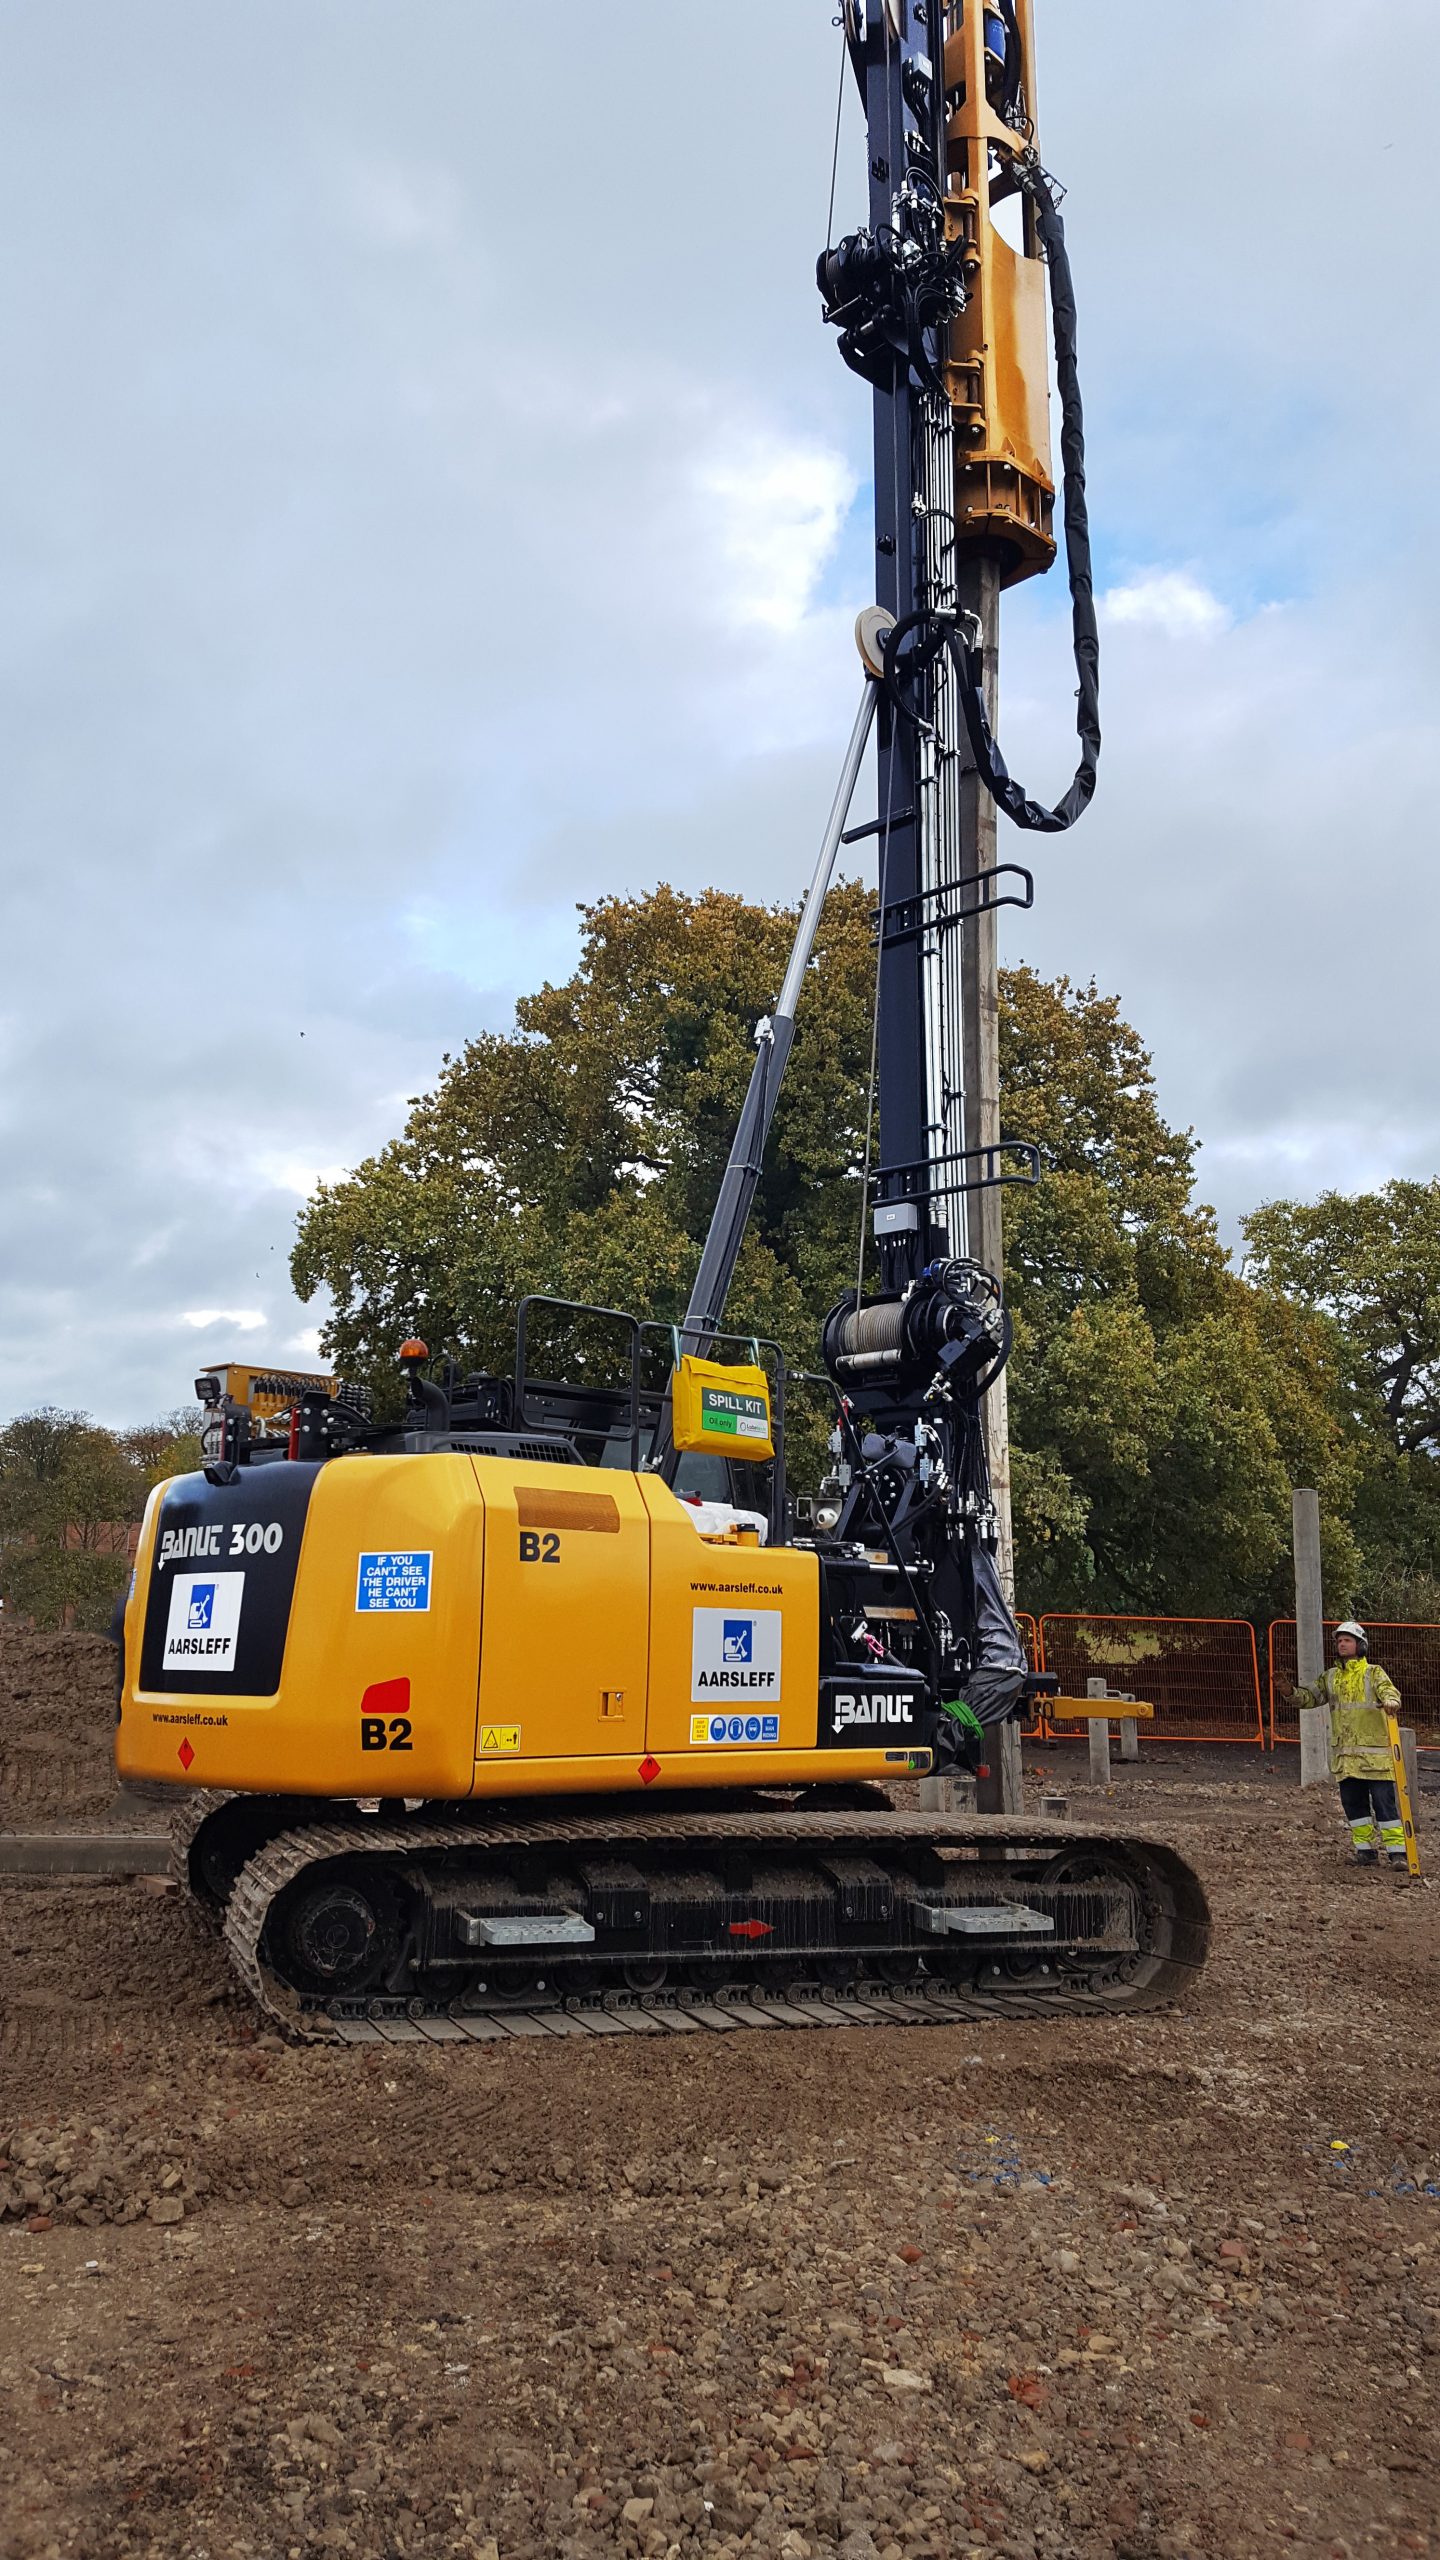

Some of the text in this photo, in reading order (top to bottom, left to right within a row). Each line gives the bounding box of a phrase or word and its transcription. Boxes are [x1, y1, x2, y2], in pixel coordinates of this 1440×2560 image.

[709, 1394, 762, 1414] SPILL KIT
[719, 1419, 732, 1428] only
[160, 1523, 283, 1561] BANUT 300
[520, 1531, 560, 1563] B2
[377, 1556, 413, 1565] IF YOU
[367, 1566, 423, 1576] CAN'T SEE
[362, 1577, 426, 1587] THE DRIVER
[690, 1583, 783, 1594] www.aarsleff.co.uk
[368, 1587, 418, 1597] HE CAN'T
[369, 1598, 417, 1608] SEE YOU
[168, 1638, 231, 1655] AARSLEFF
[698, 1671, 775, 1687] AARSLEFF
[834, 1695, 914, 1724] BANUT
[152, 1713, 228, 1726] www.aarsleff.co.uk
[361, 1718, 413, 1751] B2
